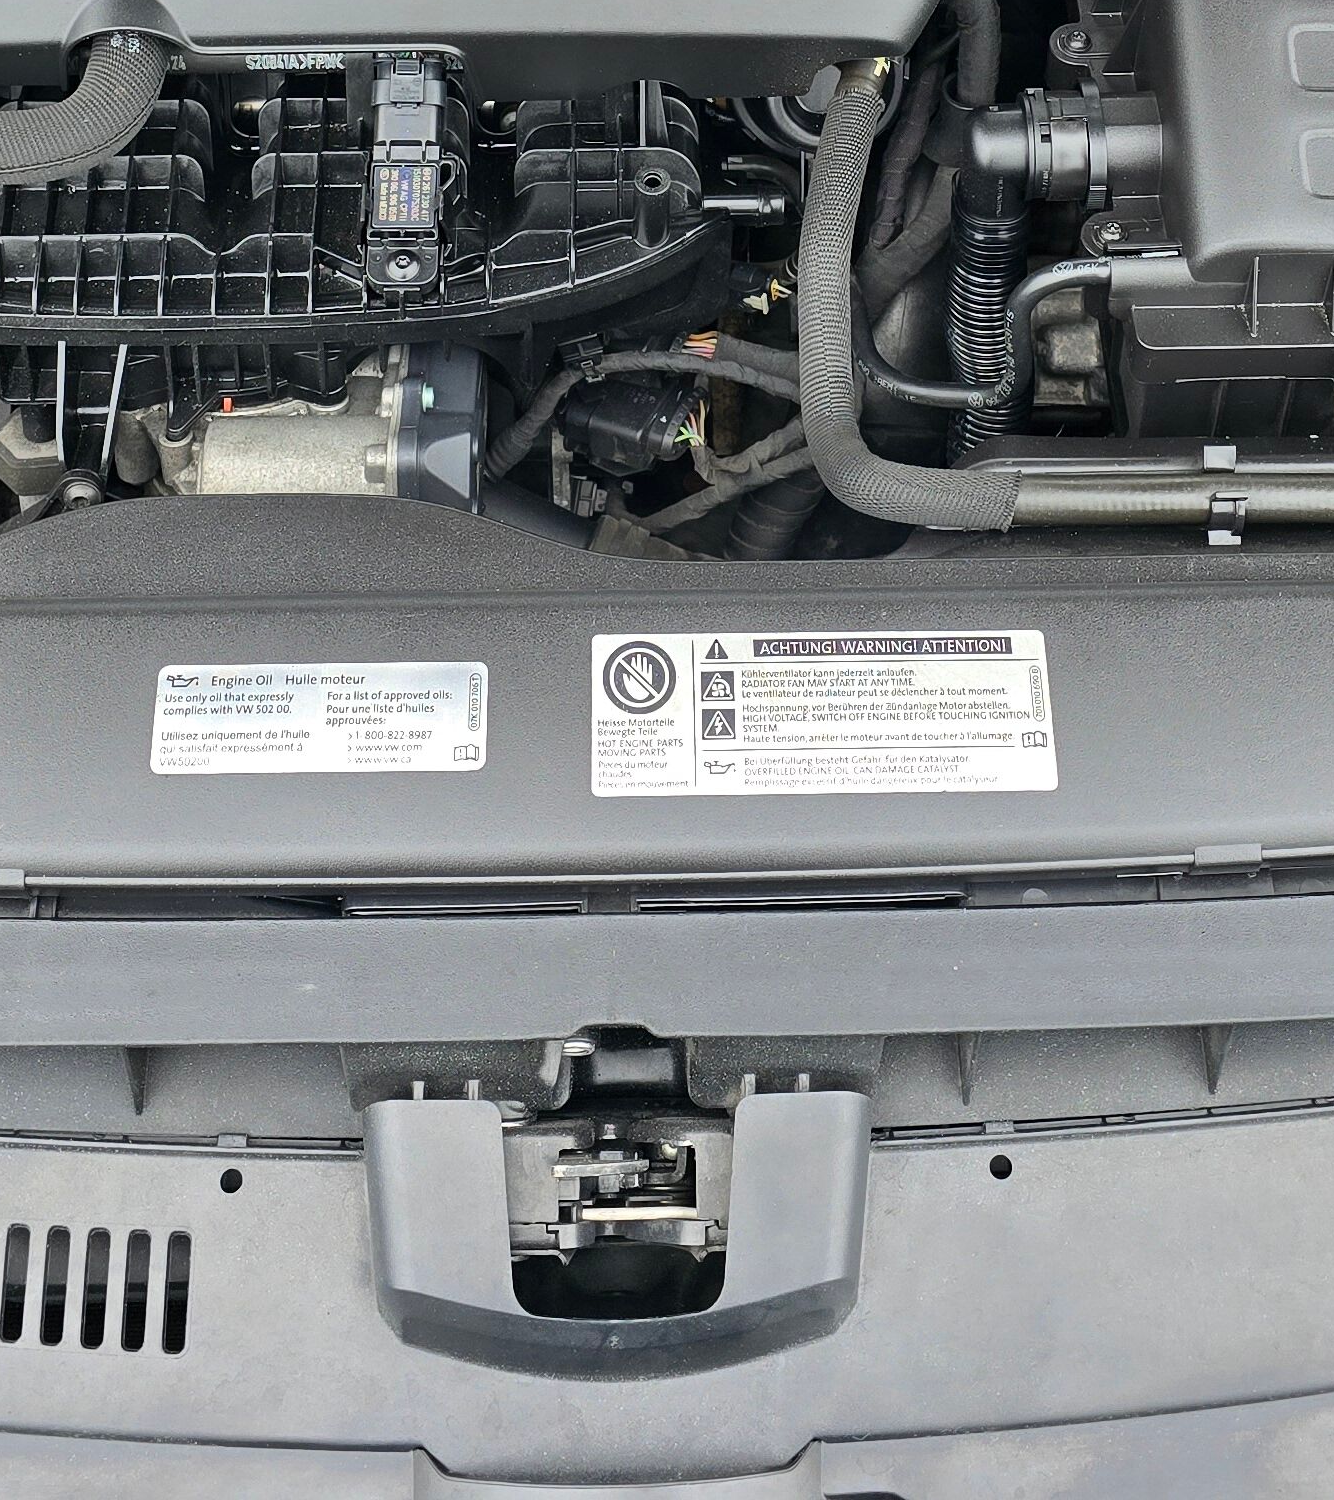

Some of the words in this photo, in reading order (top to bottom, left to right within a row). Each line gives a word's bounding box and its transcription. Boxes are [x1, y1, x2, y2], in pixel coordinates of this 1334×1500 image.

[759, 641, 836, 654] ACHTUNG!
[840, 640, 917, 653] WARNING!
[921, 639, 1006, 653] ATTENTION!
[741, 668, 811, 678] Kühlerventilator
[813, 668, 835, 677] kann
[837, 668, 873, 679] jederzeit
[877, 668, 917, 676] anlaufen.
[211, 675, 252, 689] Engine
[256, 674, 272, 686] Oil
[285, 674, 317, 685] Huile
[320, 675, 365, 685] moteur
[807, 679, 827, 687] MAY
[829, 679, 855, 687] START
[870, 678, 888, 686] ANY
[891, 678, 915, 686] TIME.
[165, 694, 183, 702] Use
[186, 693, 207, 704] only
[210, 693, 221, 701] oil
[224, 693, 245, 701] that
[248, 692, 294, 704] expressly
[327, 692, 343, 700] For
[354, 691, 368, 700] list
[371, 691, 382, 700] of
[384, 690, 430, 702] approved
[433, 690, 452, 700] oils:
[753, 689, 800, 698] ventilateur
[803, 689, 813, 697] de
[816, 689, 855, 697] radiateur
[857, 689, 877, 698] peut
[891, 688, 937, 696] déclencher
[163, 706, 208, 717] complies
[210, 705, 232, 715] with
[236, 705, 253, 714] VW
[256, 705, 273, 714] 502
[276, 704, 292, 714] 00.
[326, 704, 349, 714] Pour
[352, 705, 370, 713] une
[373, 704, 393, 713] liste
[396, 703, 435, 713] d'huiles
[471, 699, 479, 712] 010
[828, 703, 867, 711] Berühren
[870, 703, 883, 711] der
[886, 702, 937, 713] Zündanlage
[939, 702, 966, 710] Motor
[326, 715, 386, 727] approuvées:
[743, 714, 766, 722] HIGH
[812, 713, 846, 721] SWITCH
[867, 712, 901, 720] ENGINE
[903, 712, 936, 720] BEFORE
[939, 711, 986, 720] TOUCHING
[989, 711, 1030, 719] IGNITION
[597, 719, 626, 727] Heisse
[628, 718, 675, 726] Motorteile
[161, 731, 198, 741] Utilisez
[201, 730, 262, 742] uniquement
[265, 730, 277, 739] de
[280, 729, 310, 739] l'huile
[597, 728, 636, 738] Bewegte
[638, 728, 658, 736] Teile
[885, 732, 909, 740] avant
[912, 732, 923, 740] de
[924, 732, 957, 740] toucher
[619, 739, 653, 747] ENGINE
[657, 739, 683, 747] PARTS
[640, 748, 666, 756] PARTS
[799, 767, 832, 775] ENGINE
[854, 766, 872, 774] CAN
[875, 765, 914, 774] DAMAGE
